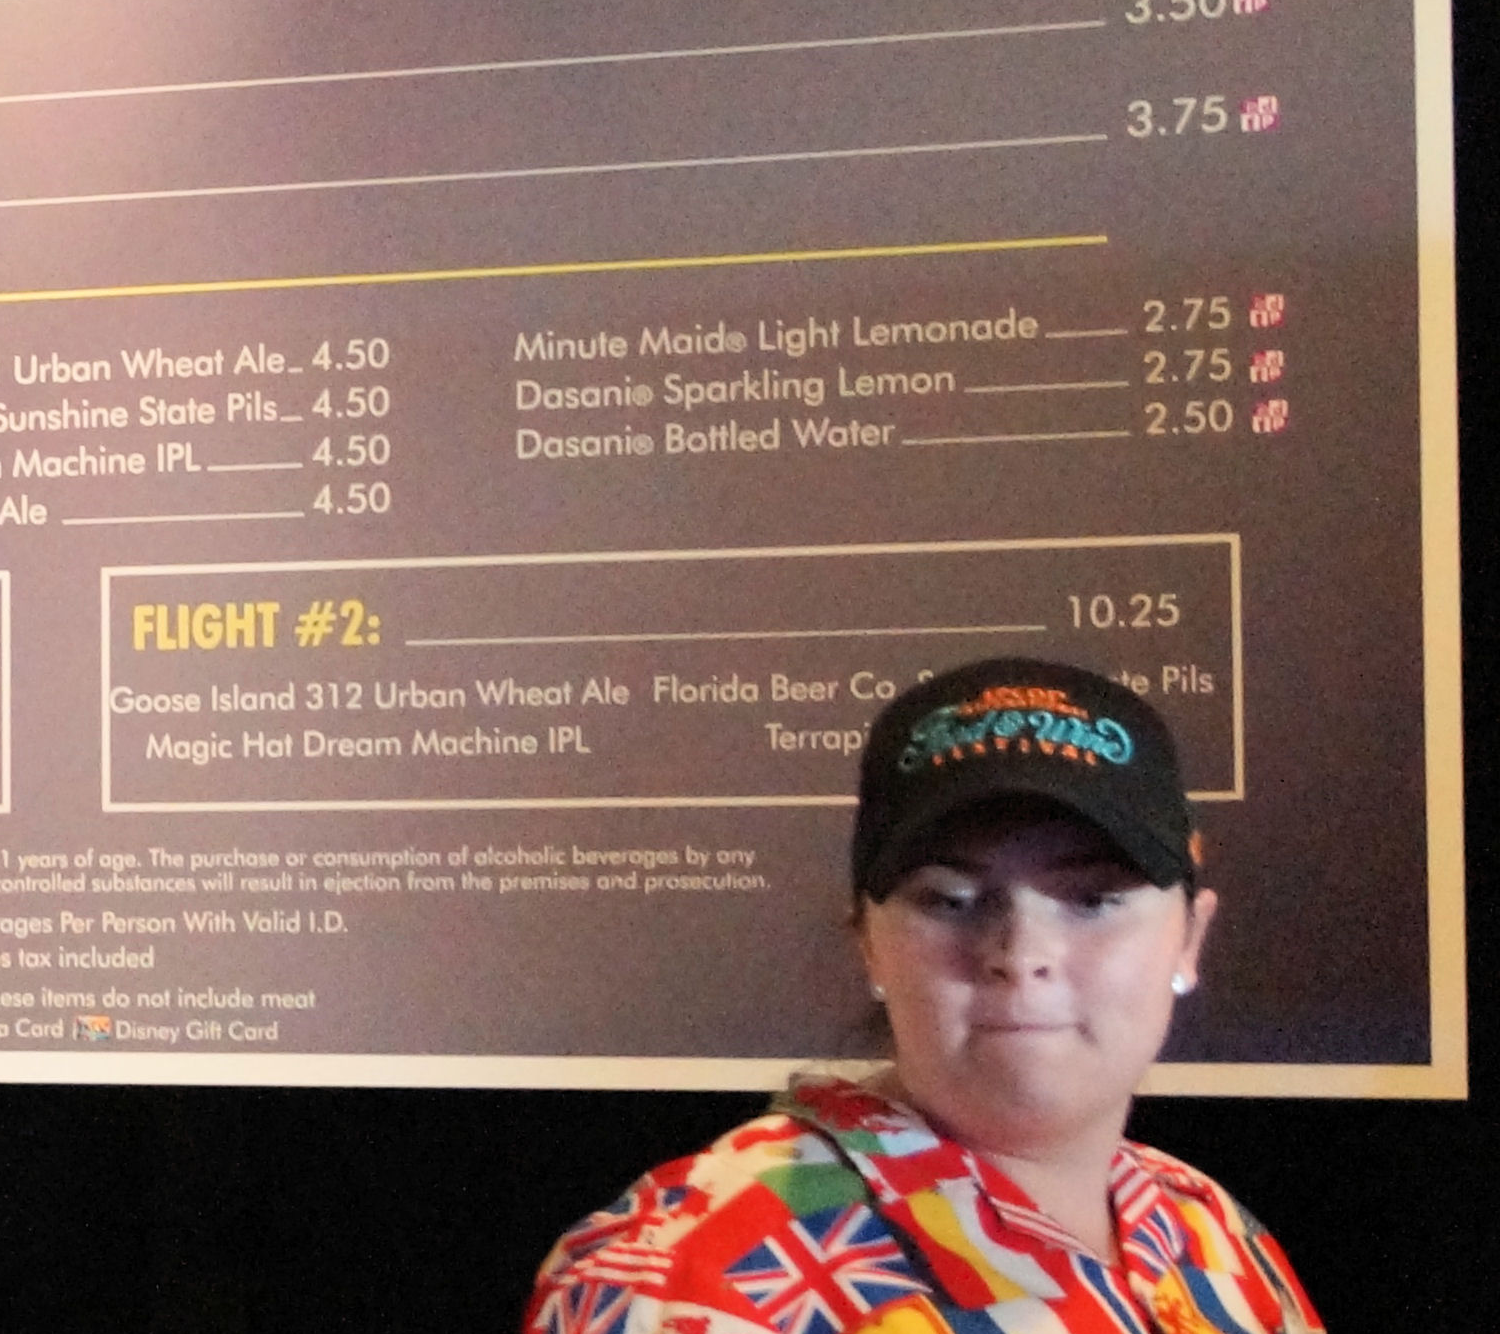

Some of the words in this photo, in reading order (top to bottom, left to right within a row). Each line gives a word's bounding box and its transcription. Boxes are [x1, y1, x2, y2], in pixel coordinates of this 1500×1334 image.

[1126, 94, 1228, 139] 3.75
[513, 329, 629, 363] Minute
[757, 316, 841, 358] Light
[852, 306, 1039, 347] Lemonade
[1142, 295, 1232, 334] 2.75
[13, 351, 112, 385] Urban
[120, 346, 224, 379] Wheat
[233, 341, 286, 376] Ale
[311, 337, 390, 371] 4.50
[662, 367, 826, 412] Sparkling
[838, 366, 956, 398] Lemon
[1143, 347, 1233, 384] 2.75
[139, 395, 217, 428] State
[226, 390, 278, 422] Pils
[311, 385, 391, 419] 4.50
[665, 417, 781, 455] Bottled
[790, 416, 896, 448] Water
[1144, 398, 1234, 436] 2.50
[133, 601, 281, 651] FLIGHT
[294, 599, 381, 647] #2:
[1068, 592, 1181, 630] 10.25
[18, 948, 52, 969] tax
[57, 943, 155, 969] included
